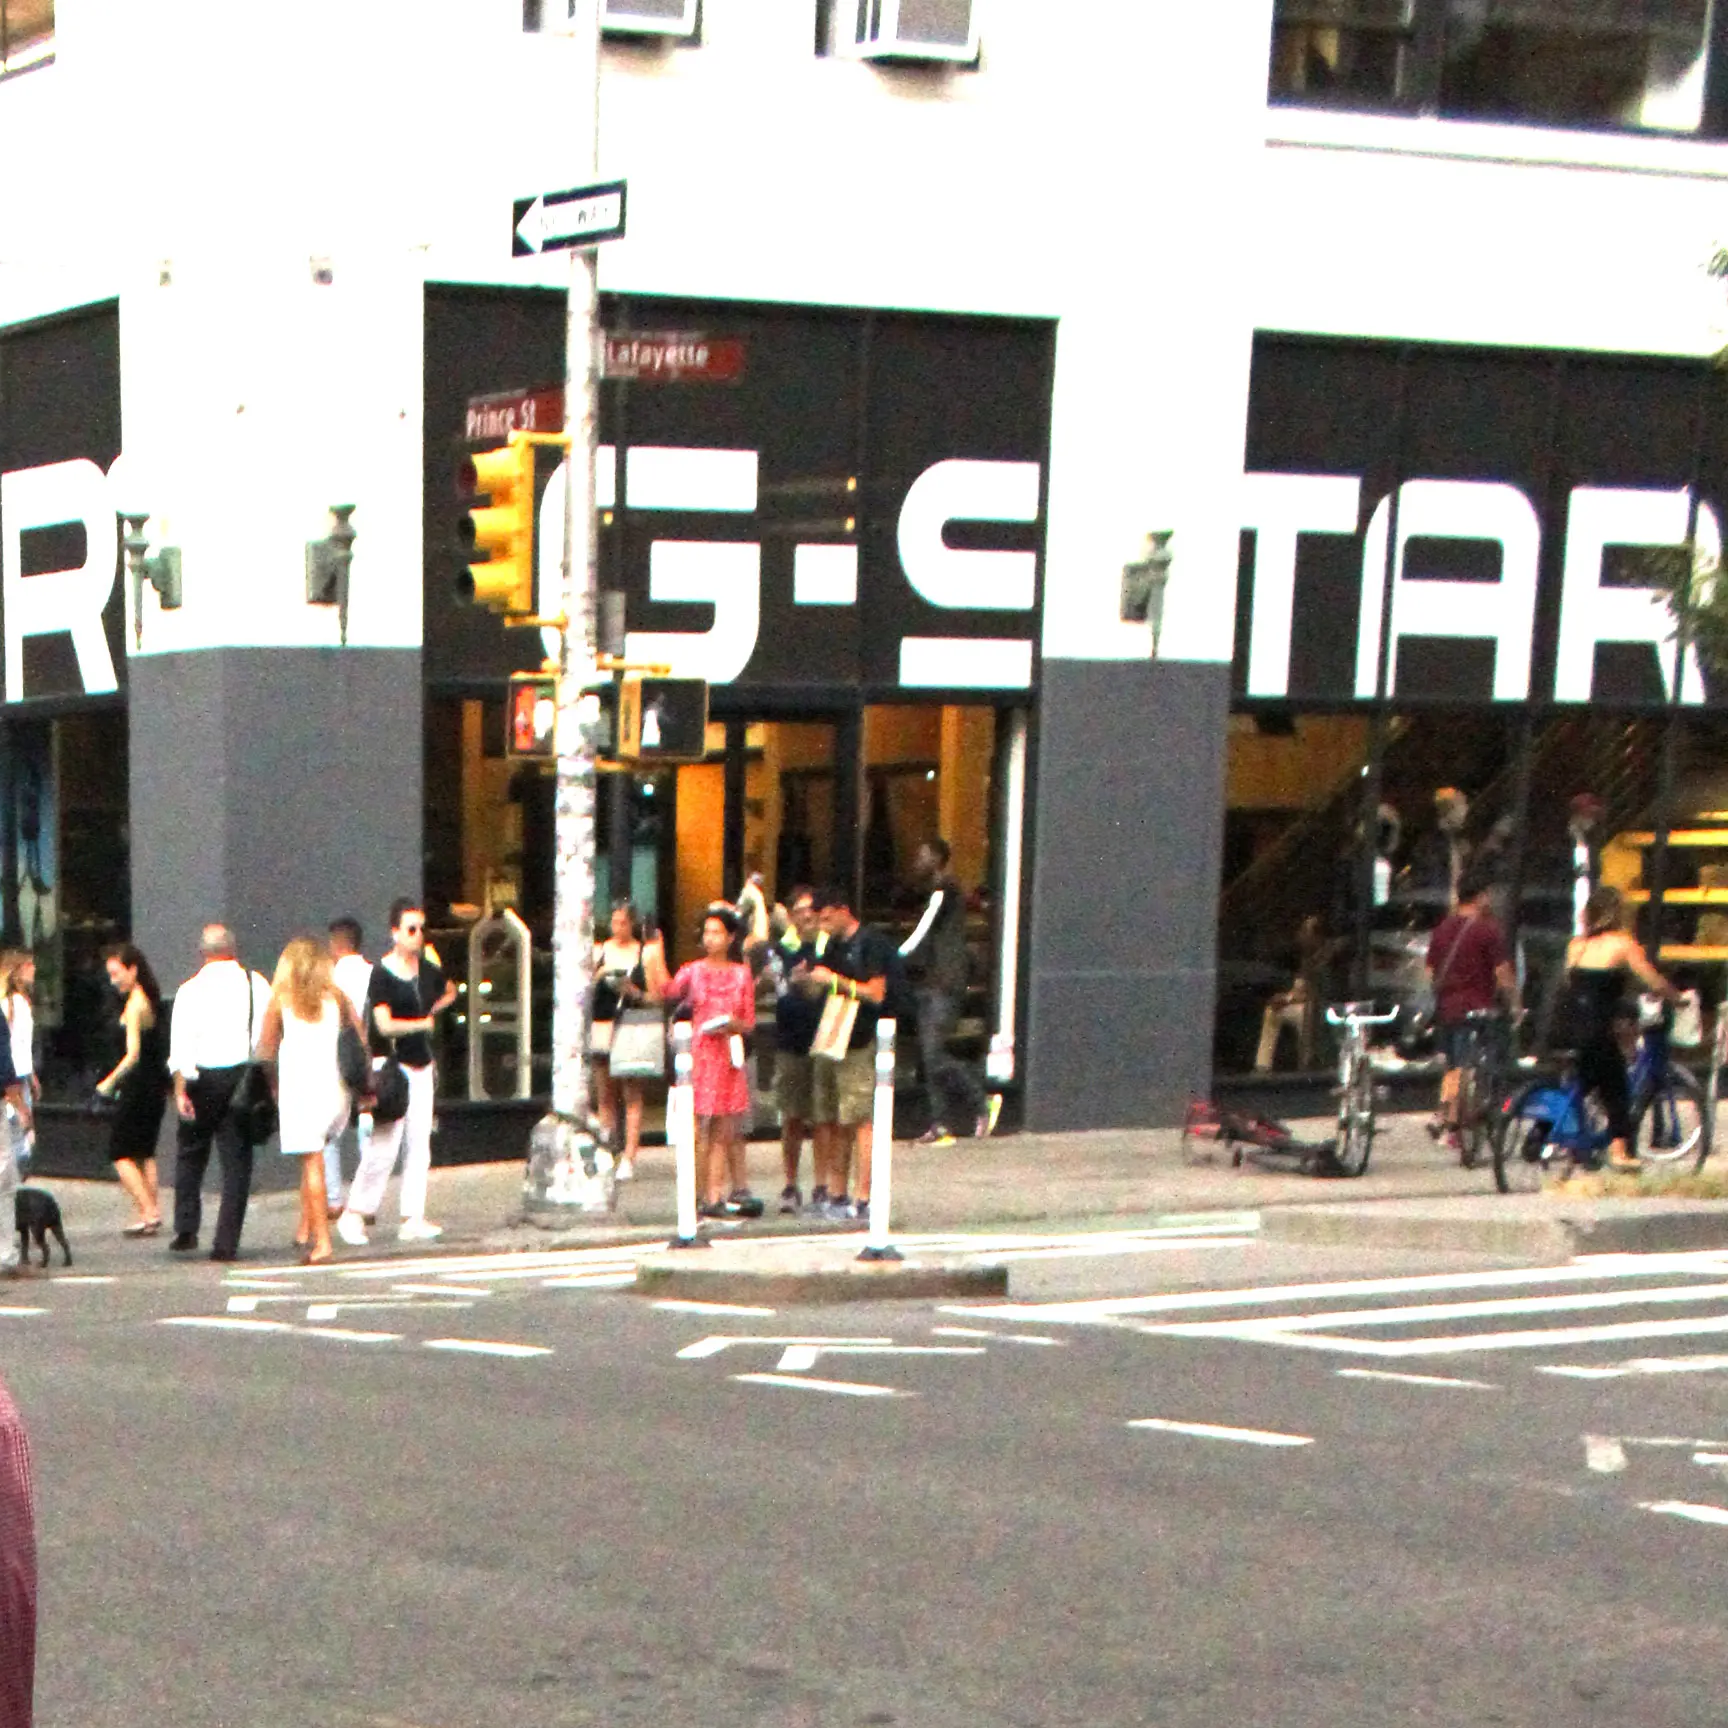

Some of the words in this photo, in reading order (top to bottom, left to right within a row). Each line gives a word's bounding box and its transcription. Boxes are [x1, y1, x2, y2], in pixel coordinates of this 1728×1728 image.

[605, 339, 709, 372] Lafayette
[466, 403, 516, 441] Prince
[521, 398, 537, 430] St
